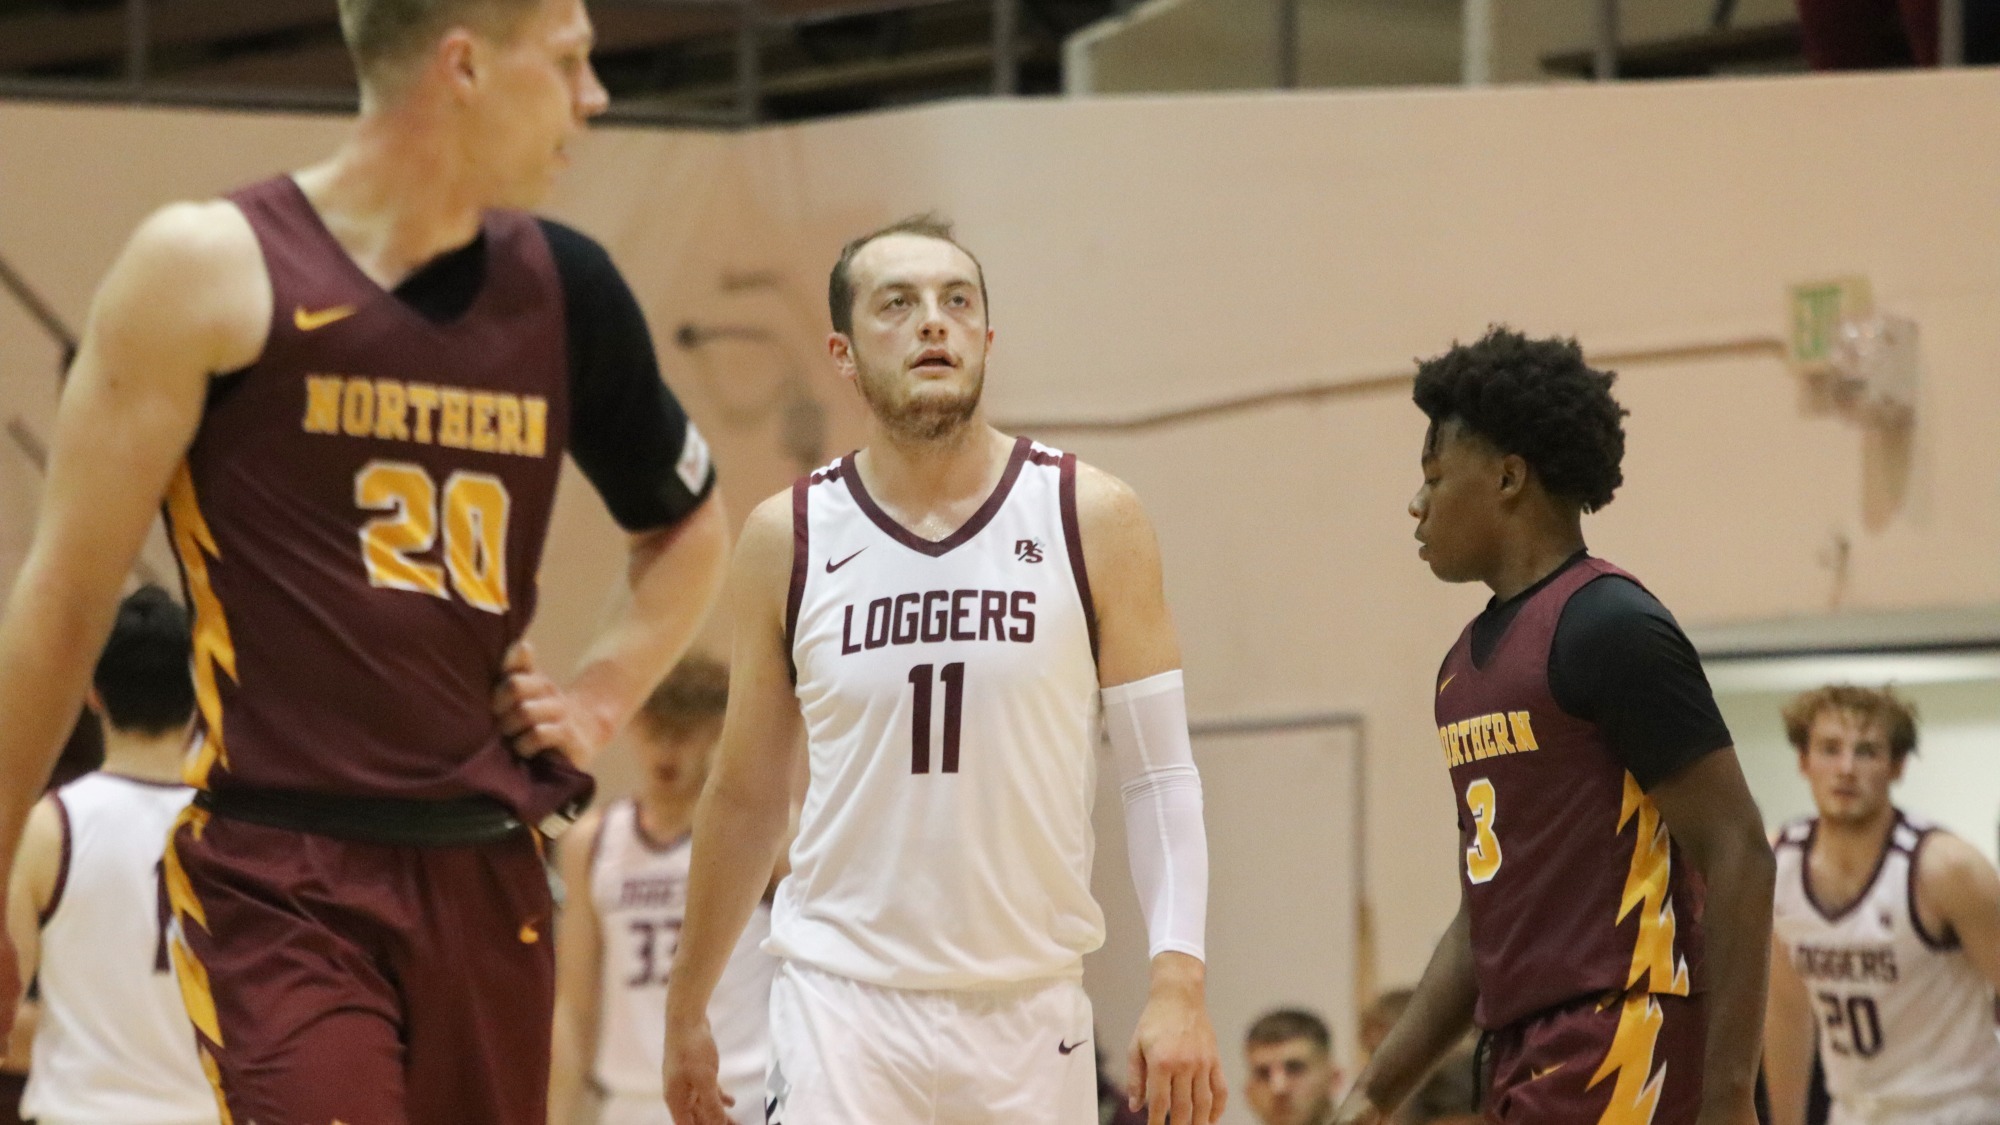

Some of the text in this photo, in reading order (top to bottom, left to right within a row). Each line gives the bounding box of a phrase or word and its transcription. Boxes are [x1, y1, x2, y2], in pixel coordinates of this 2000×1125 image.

[303, 374, 548, 458] NORTHERN
[354, 459, 511, 615] 20
[841, 589, 1036, 656] LOGGERS
[908, 662, 965, 775] 11
[1439, 710, 1539, 769] ORTHERN
[1466, 777, 1502, 885] 3
[1817, 989, 1882, 1056] 20
